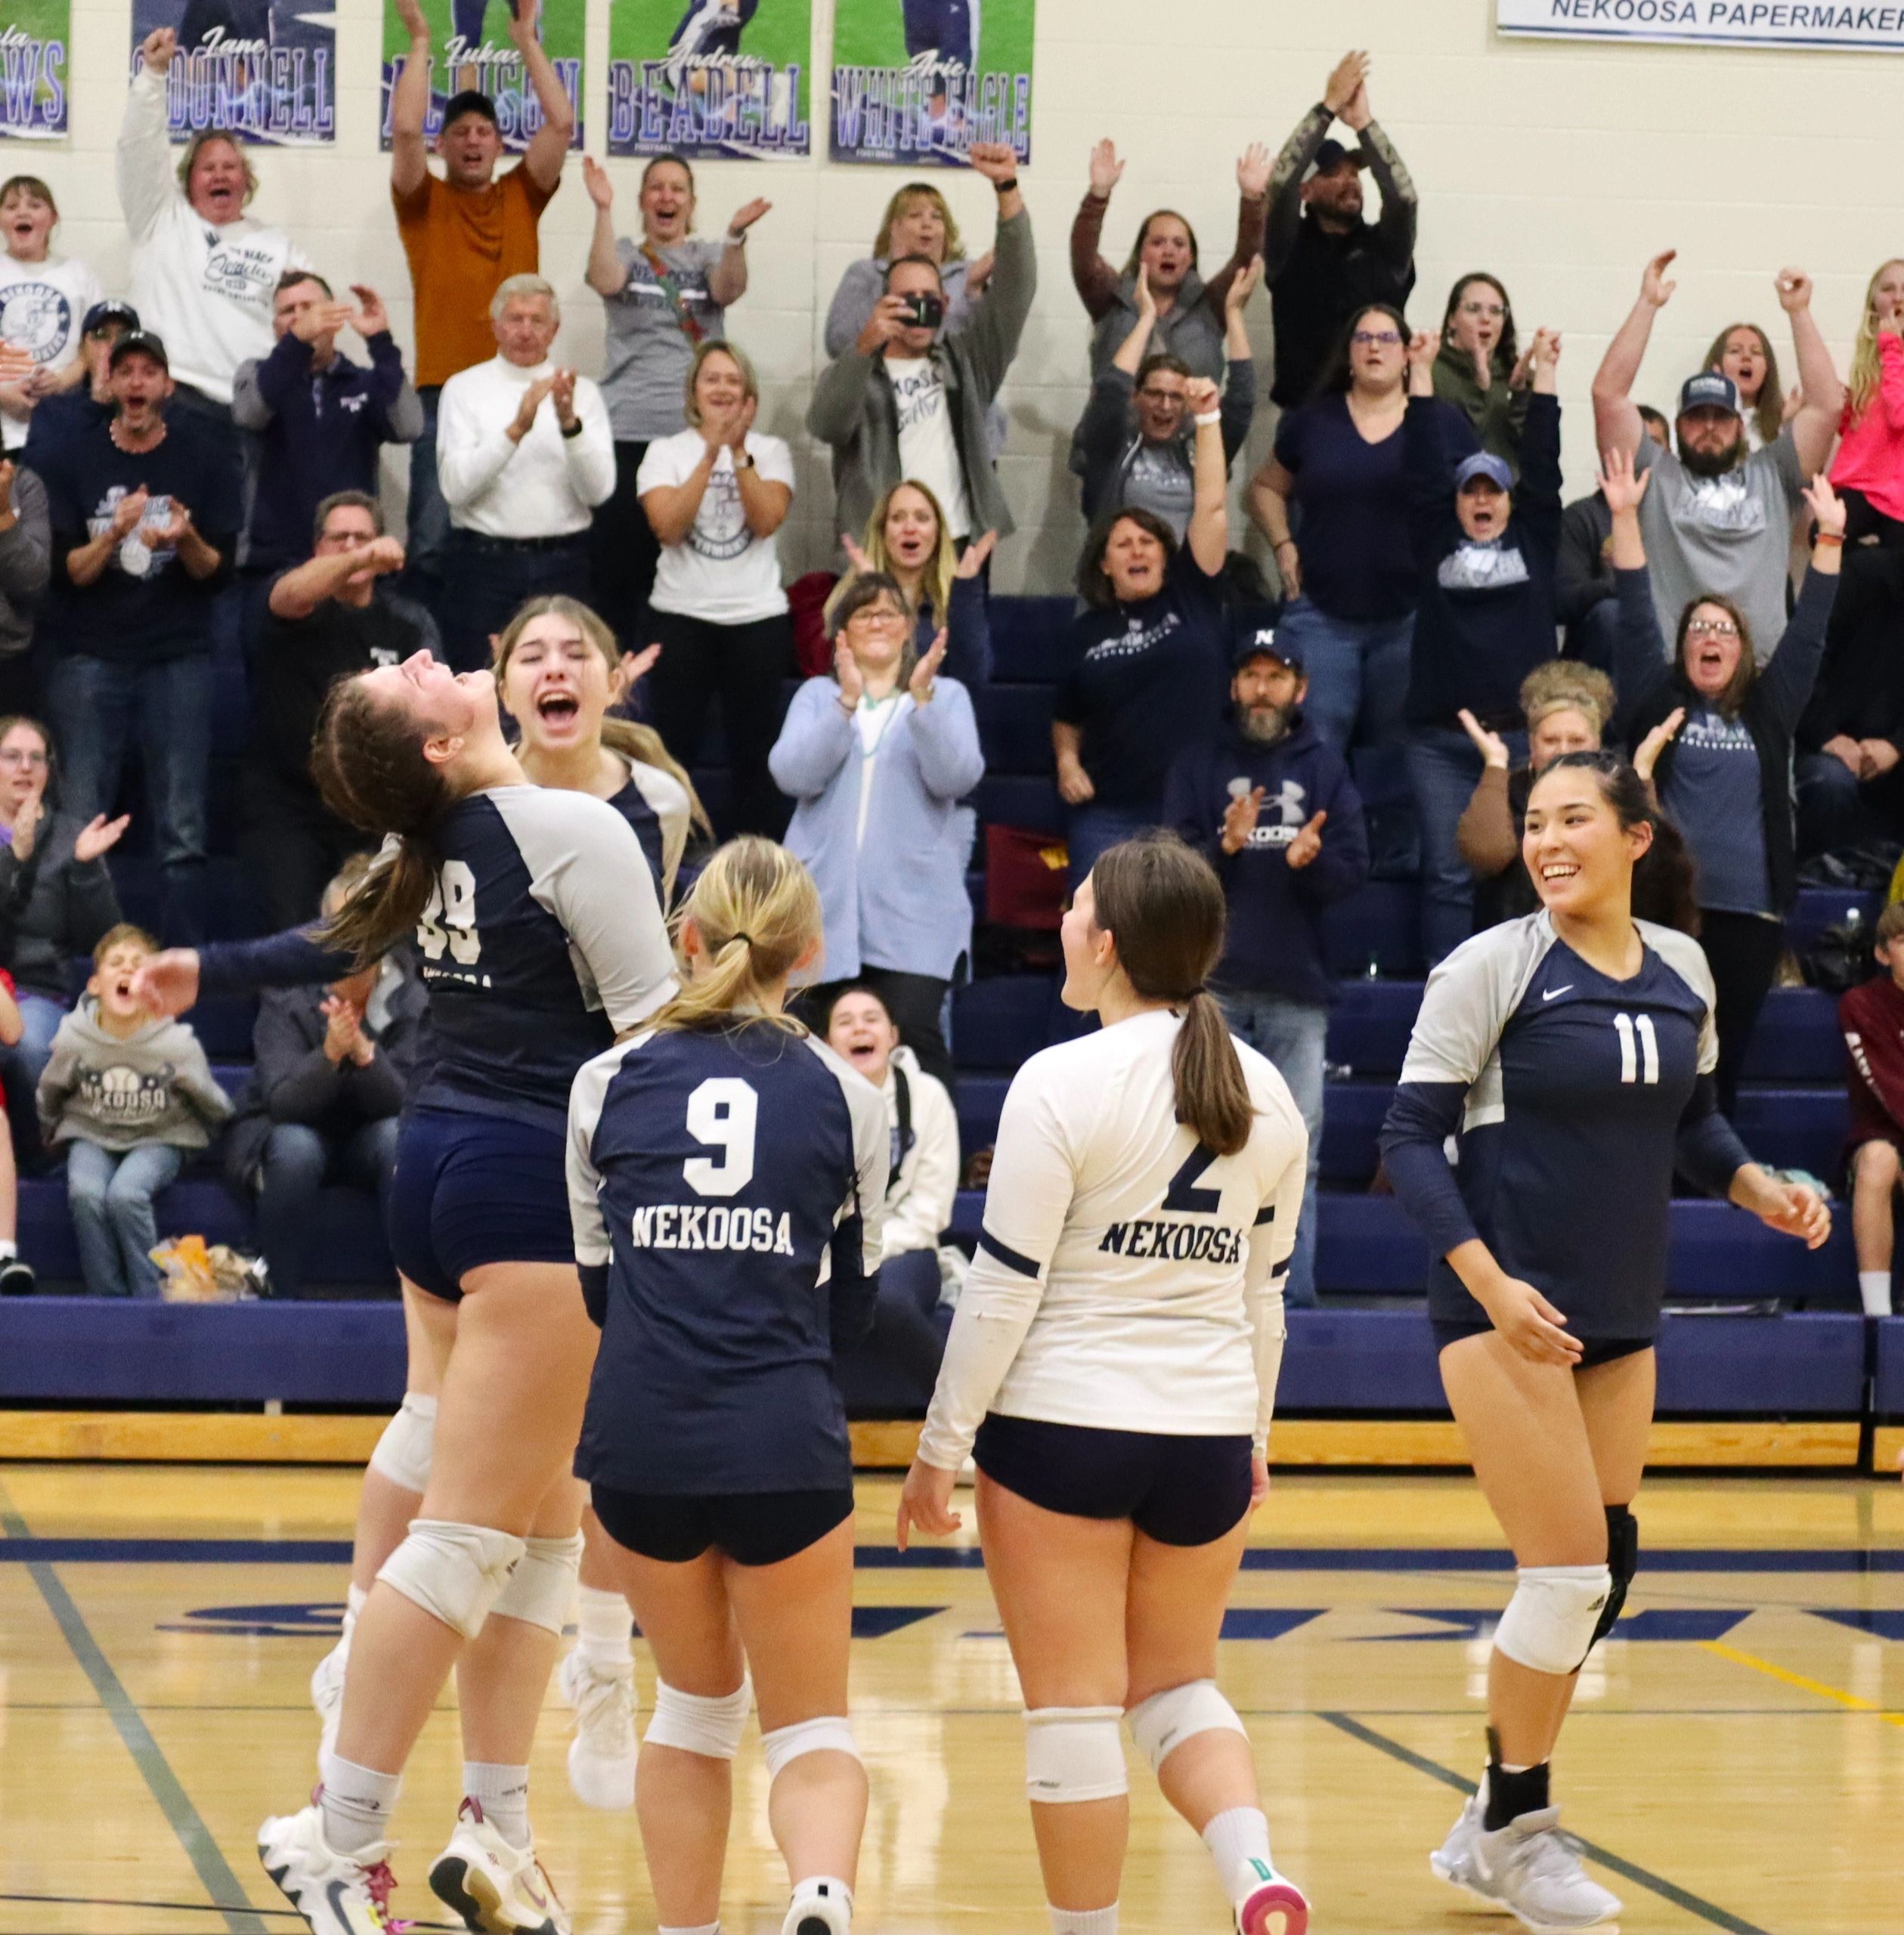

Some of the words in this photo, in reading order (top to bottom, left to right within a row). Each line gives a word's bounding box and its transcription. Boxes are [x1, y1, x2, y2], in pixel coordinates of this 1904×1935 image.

[1551, 0, 1697, 23] NEKOOSA
[201, 25, 265, 58] Lane
[608, 60, 810, 147] BEADELL
[1254, 629, 1274, 646] N
[1614, 1012, 1660, 1084] 11
[683, 1077, 758, 1197] 9
[632, 1205, 794, 1256] NEKOOSA
[1098, 1221, 1240, 1265] NEKOOSA
